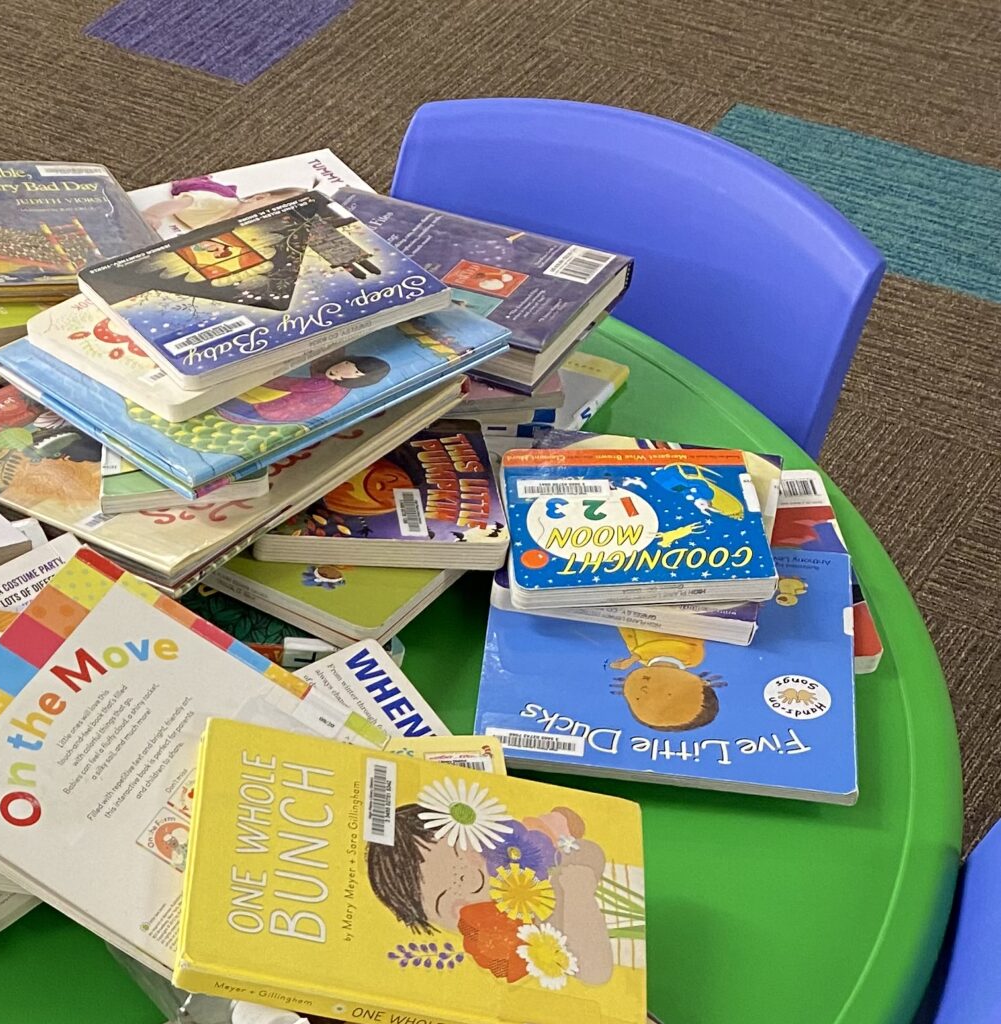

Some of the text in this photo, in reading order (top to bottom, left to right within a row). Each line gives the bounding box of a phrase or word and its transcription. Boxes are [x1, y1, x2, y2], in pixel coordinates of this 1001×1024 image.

[307, 158, 344, 184] TUMMY
[22, 182, 60, 191] Bad
[61, 182, 98, 192] Day
[346, 275, 427, 308] Sleep,
[277, 302, 342, 334] My
[182, 327, 269, 366] Baby
[595, 454, 688, 463] Margaret Wise Brown
[410, 439, 458, 520] PUMPKIN
[440, 434, 490, 529] THIS LITTLE
[546, 496, 639, 520] 1 2 3
[546, 525, 644, 549] MOON
[557, 547, 753, 575] GOODNIGHT
[2, 570, 40, 591] COSTUME
[1, 588, 31, 607] LOTS OF
[340, 677, 359, 701] winter
[345, 648, 439, 738] WHEN
[775, 676, 819, 689] Songs
[57, 690, 109, 748] Little ones will love this
[0, 639, 179, 827] On the Move
[520, 703, 811, 765] Five Little Ducks
[348, 780, 362, 829] Gillingham
[227, 750, 276, 933] ONE WHOLE
[268, 762, 335, 943] BUNCH
[346, 834, 358, 855] Sara
[344, 872, 358, 899] Meyer
[343, 905, 357, 930] Mary
[214, 980, 314, 1007] Meyer Gillingham
[351, 1007, 383, 1022] ONE
